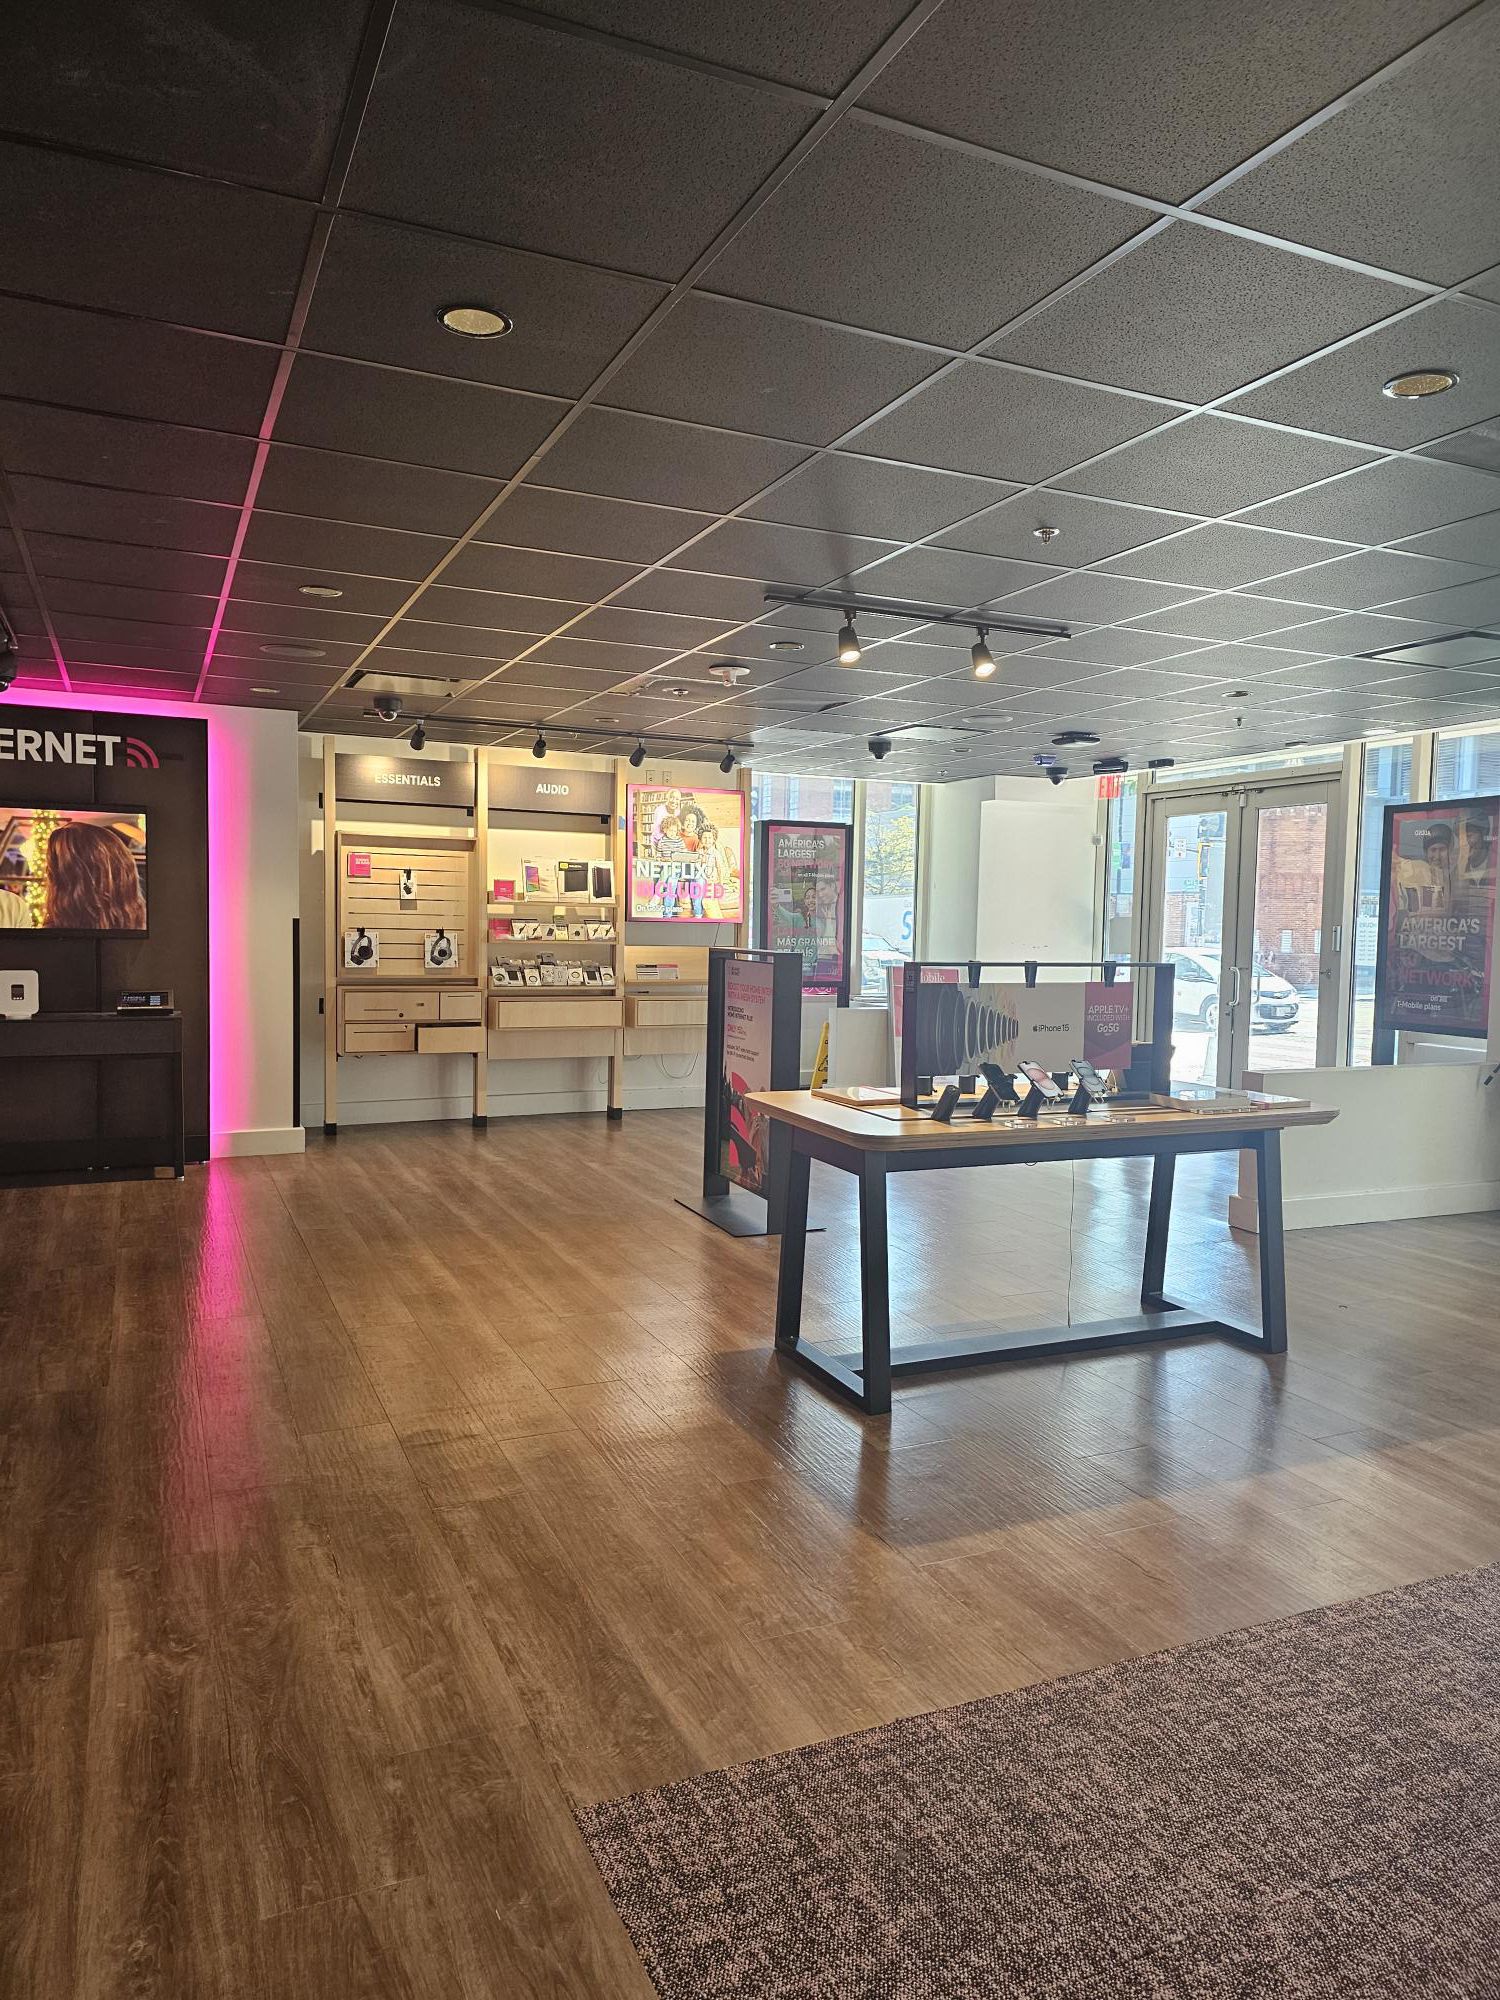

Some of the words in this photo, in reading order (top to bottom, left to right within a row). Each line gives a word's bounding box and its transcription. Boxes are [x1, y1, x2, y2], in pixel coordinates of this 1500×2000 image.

[0, 728, 121, 766] ERNET
[374, 774, 441, 787] ESSENTIALS
[1099, 775, 1121, 798] EXIT
[535, 783, 569, 796] AUDIO
[778, 839, 825, 849] AMERICA'S
[778, 848, 817, 859] LARGEST
[636, 860, 706, 880] NETFLIX
[636, 879, 725, 900] INCLUDED
[1400, 917, 1480, 934] AMERICA'S
[797, 936, 837, 947] GRANDE
[1399, 933, 1466, 951] LARGEST
[1088, 1004, 1113, 1014] APPLE
[1397, 1000, 1423, 1010] T-Mobile
[1424, 1002, 1442, 1011] plans
[1038, 1024, 1061, 1032] iPhone
[1062, 1023, 1070, 1032] 15
[1097, 1022, 1120, 1033] Go5G
